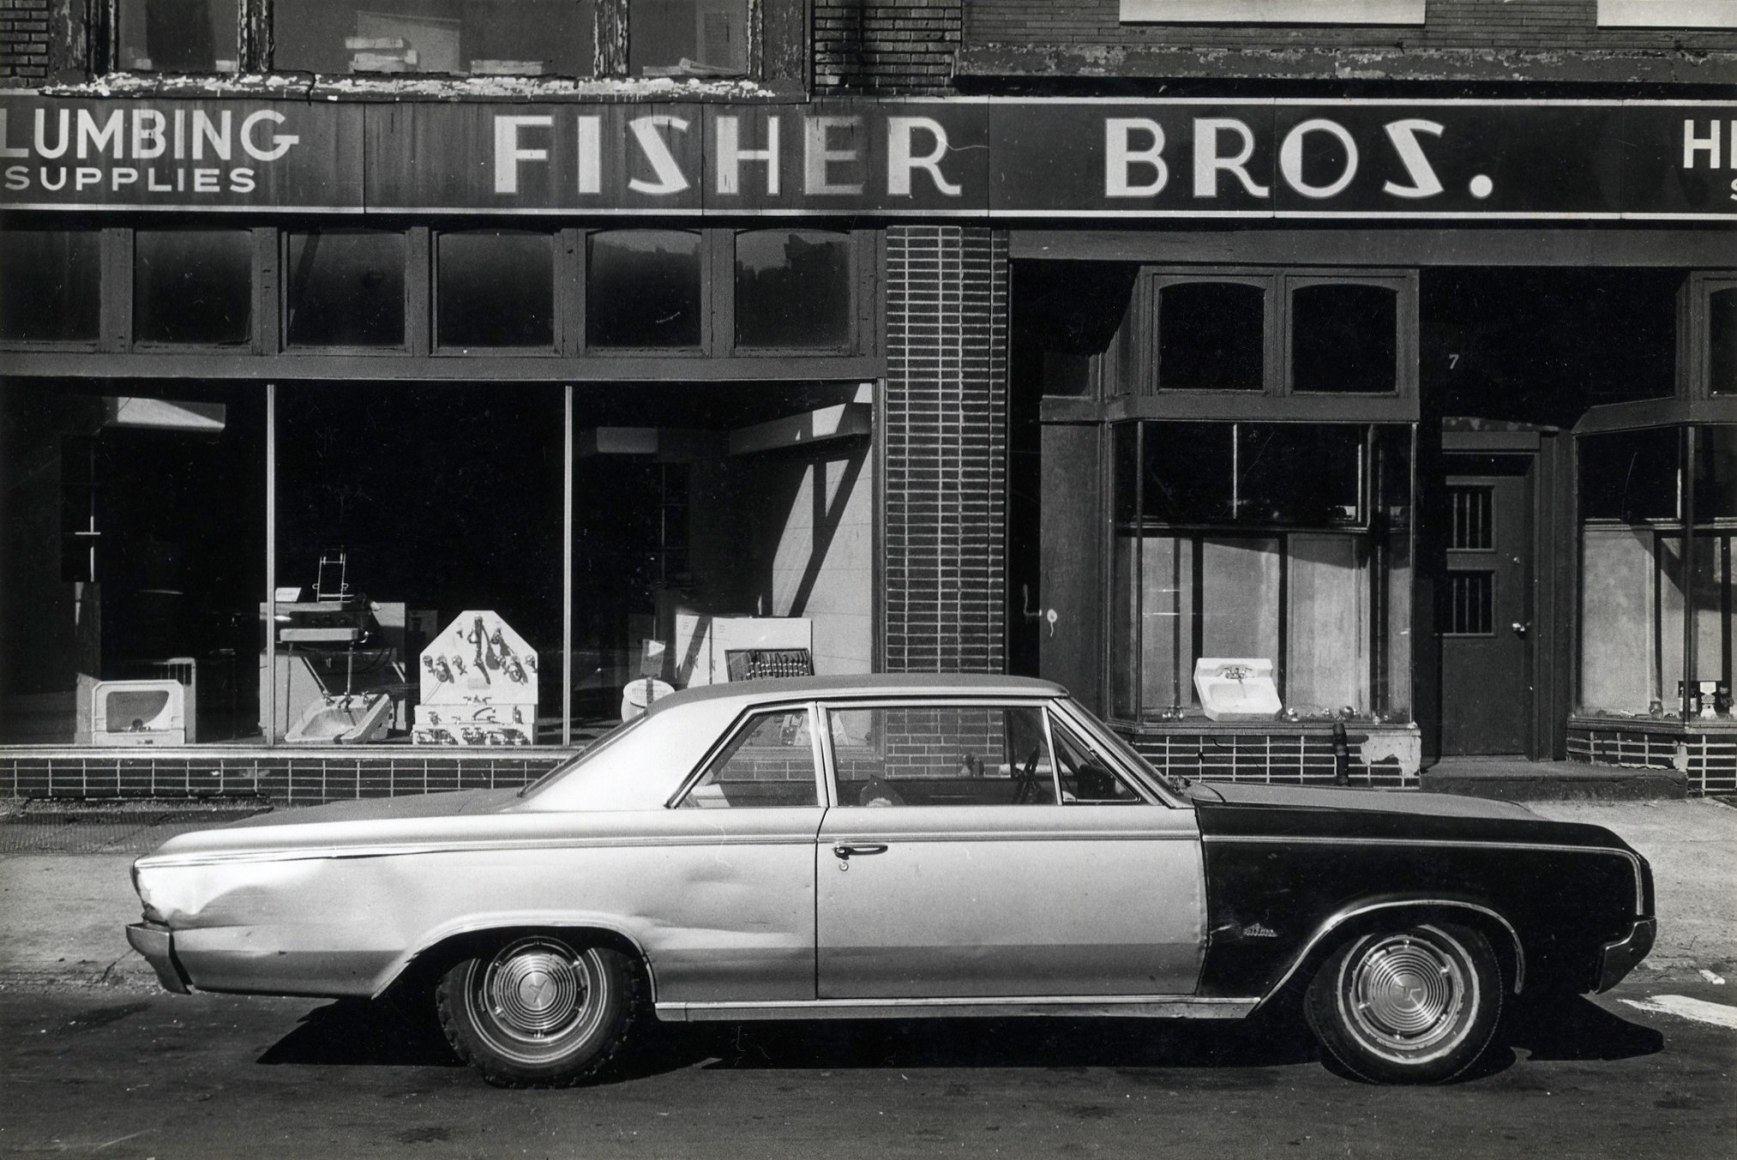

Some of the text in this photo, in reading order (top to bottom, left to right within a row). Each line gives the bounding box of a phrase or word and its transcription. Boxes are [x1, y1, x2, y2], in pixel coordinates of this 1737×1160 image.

[0, 108, 300, 161] LUMBING
[494, 115, 1494, 198] FISHER BROS.
[4, 165, 256, 193] SUPPLIES
[1449, 353, 1460, 370] 7
